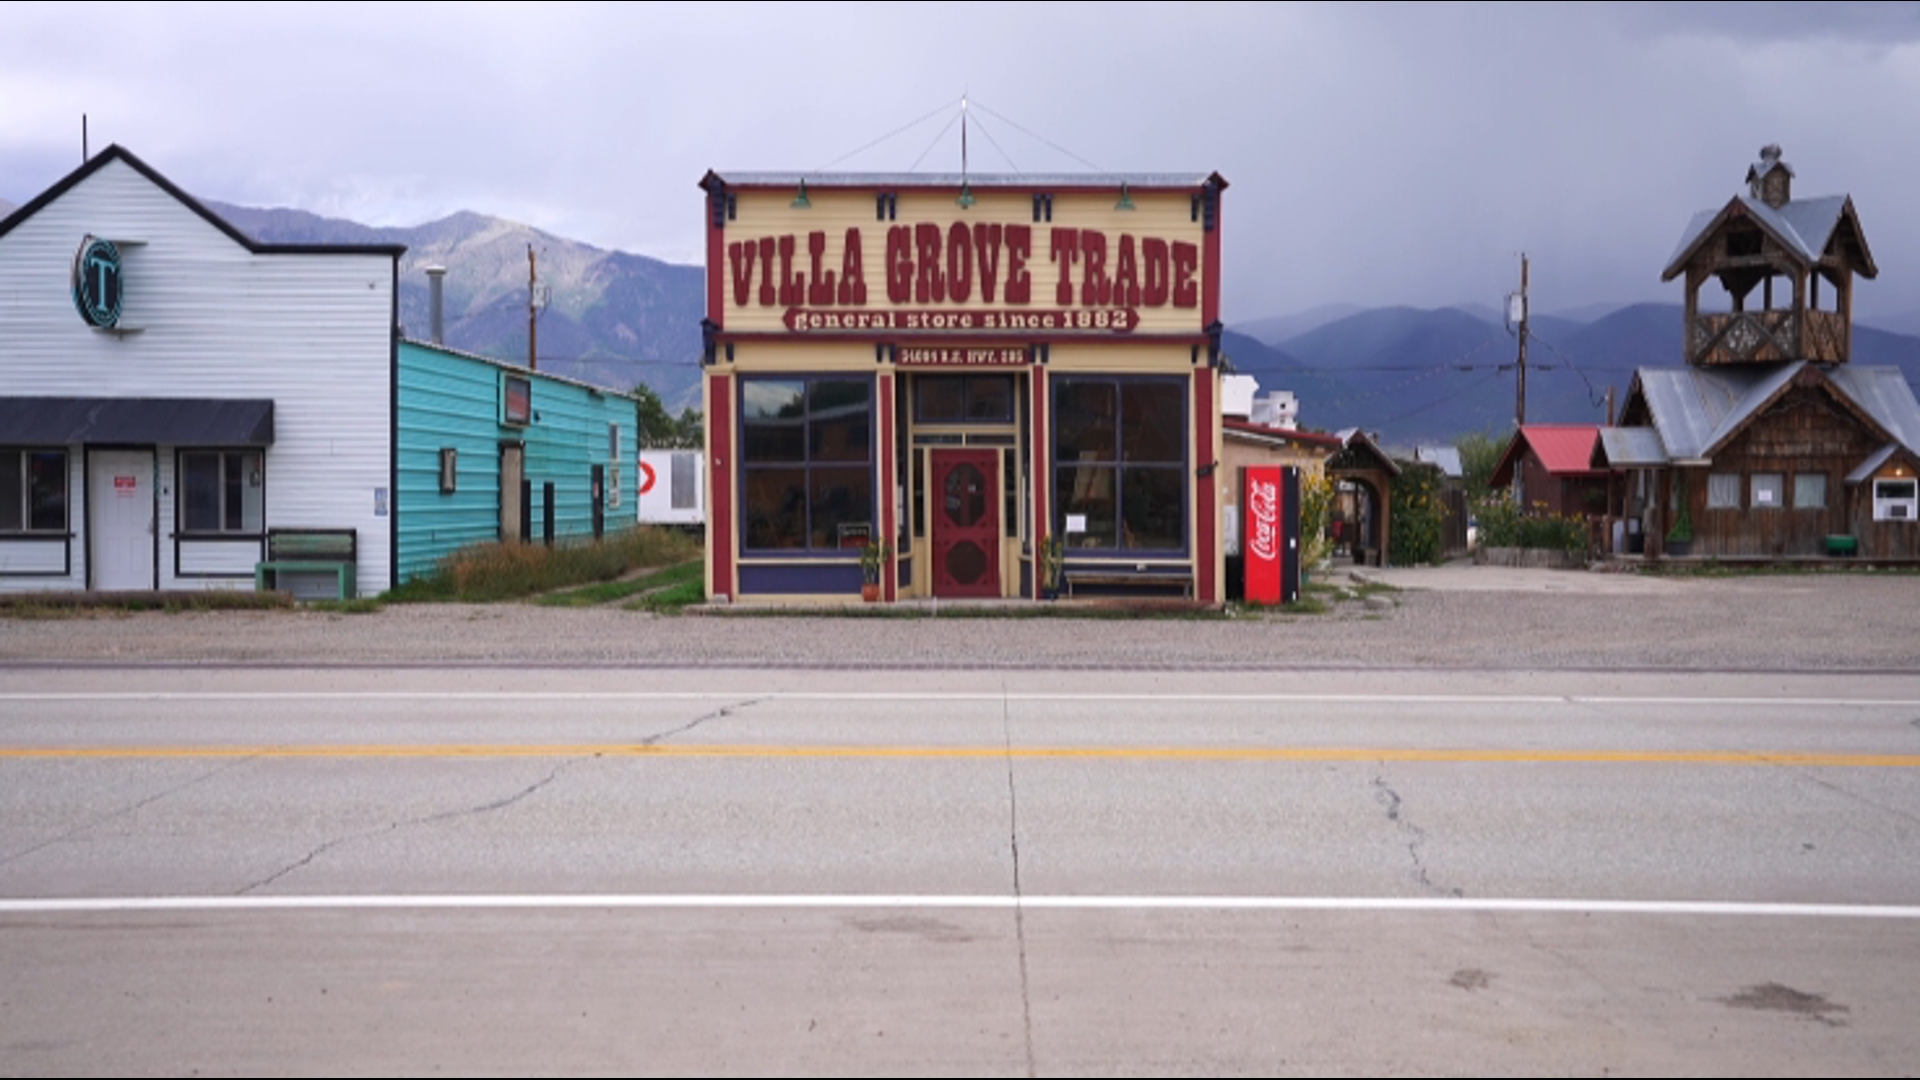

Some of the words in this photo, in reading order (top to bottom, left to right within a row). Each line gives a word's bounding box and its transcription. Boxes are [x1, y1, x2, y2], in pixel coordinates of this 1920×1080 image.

[91, 257, 115, 312] T
[729, 228, 867, 306] VILLA
[886, 221, 1032, 305] GROVE
[1050, 227, 1198, 308] TRADE
[795, 310, 896, 331] general
[907, 311, 973, 329] store
[984, 310, 1055, 329] since
[1063, 309, 1128, 329] 1882
